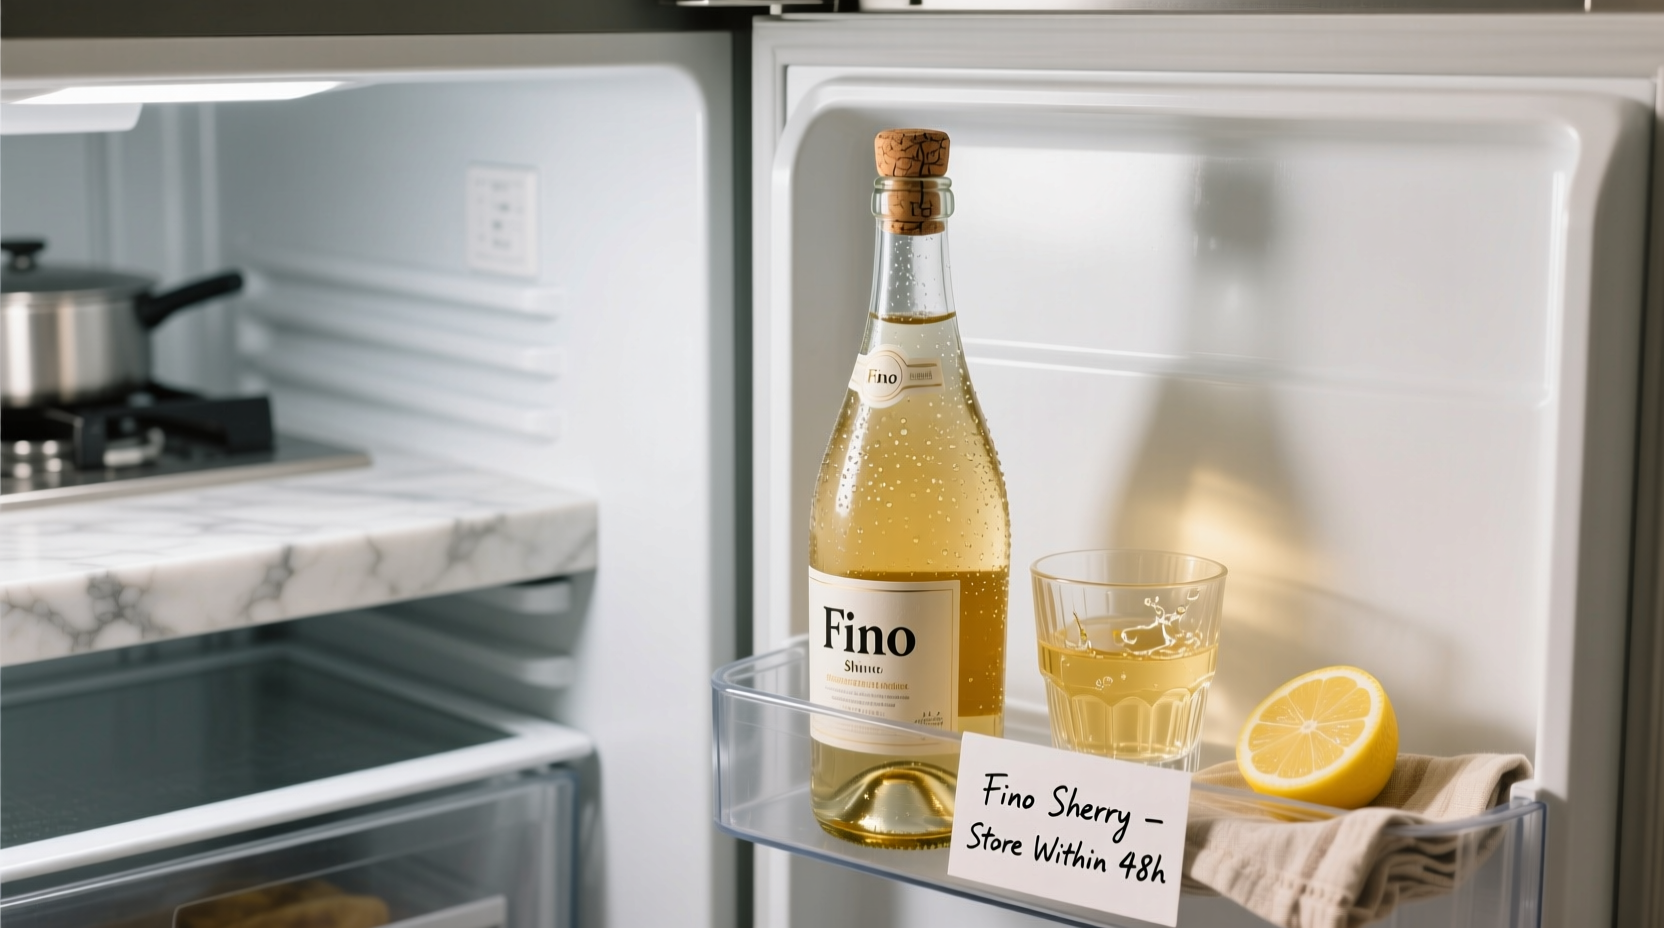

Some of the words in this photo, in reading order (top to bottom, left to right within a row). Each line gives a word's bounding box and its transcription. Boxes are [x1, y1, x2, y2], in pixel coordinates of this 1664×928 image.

[867, 368, 898, 384] Fino
[823, 605, 916, 657] Fino
[983, 773, 1035, 809] Fino
[1048, 785, 1131, 844] Sherry
[966, 822, 1023, 856] Store
[1034, 835, 1107, 873] Within
[1119, 851, 1166, 884] 48h
